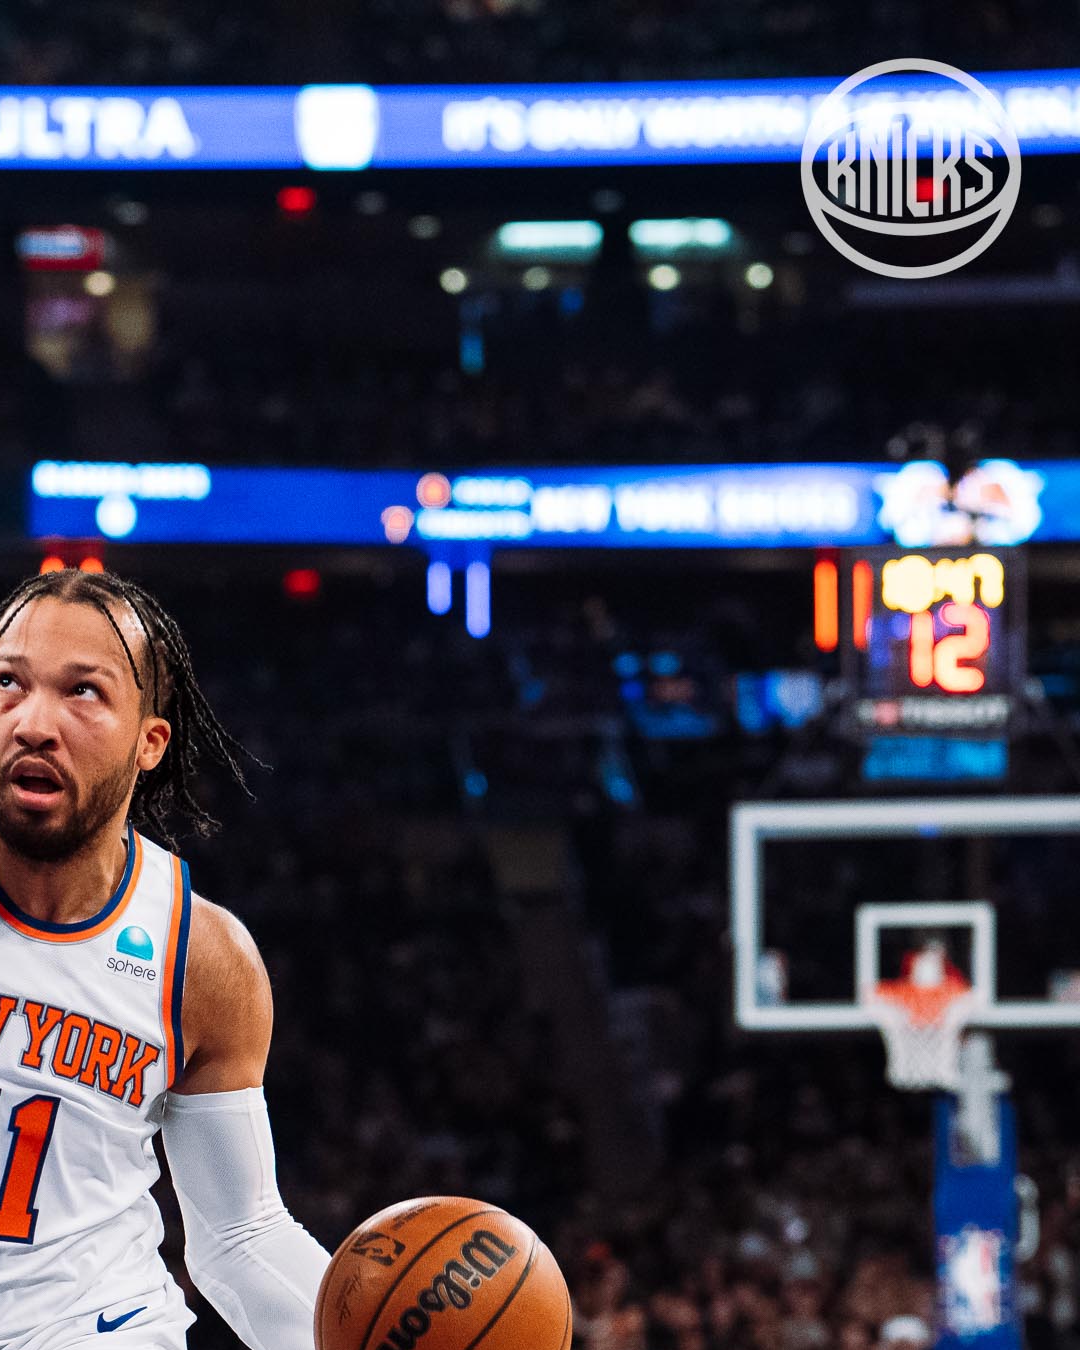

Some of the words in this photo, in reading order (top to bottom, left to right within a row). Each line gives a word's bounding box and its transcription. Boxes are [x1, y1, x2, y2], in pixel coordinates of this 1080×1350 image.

[908, 600, 990, 693] 12
[107, 957, 156, 981] sphere
[17, 1007, 164, 1108] YORK
